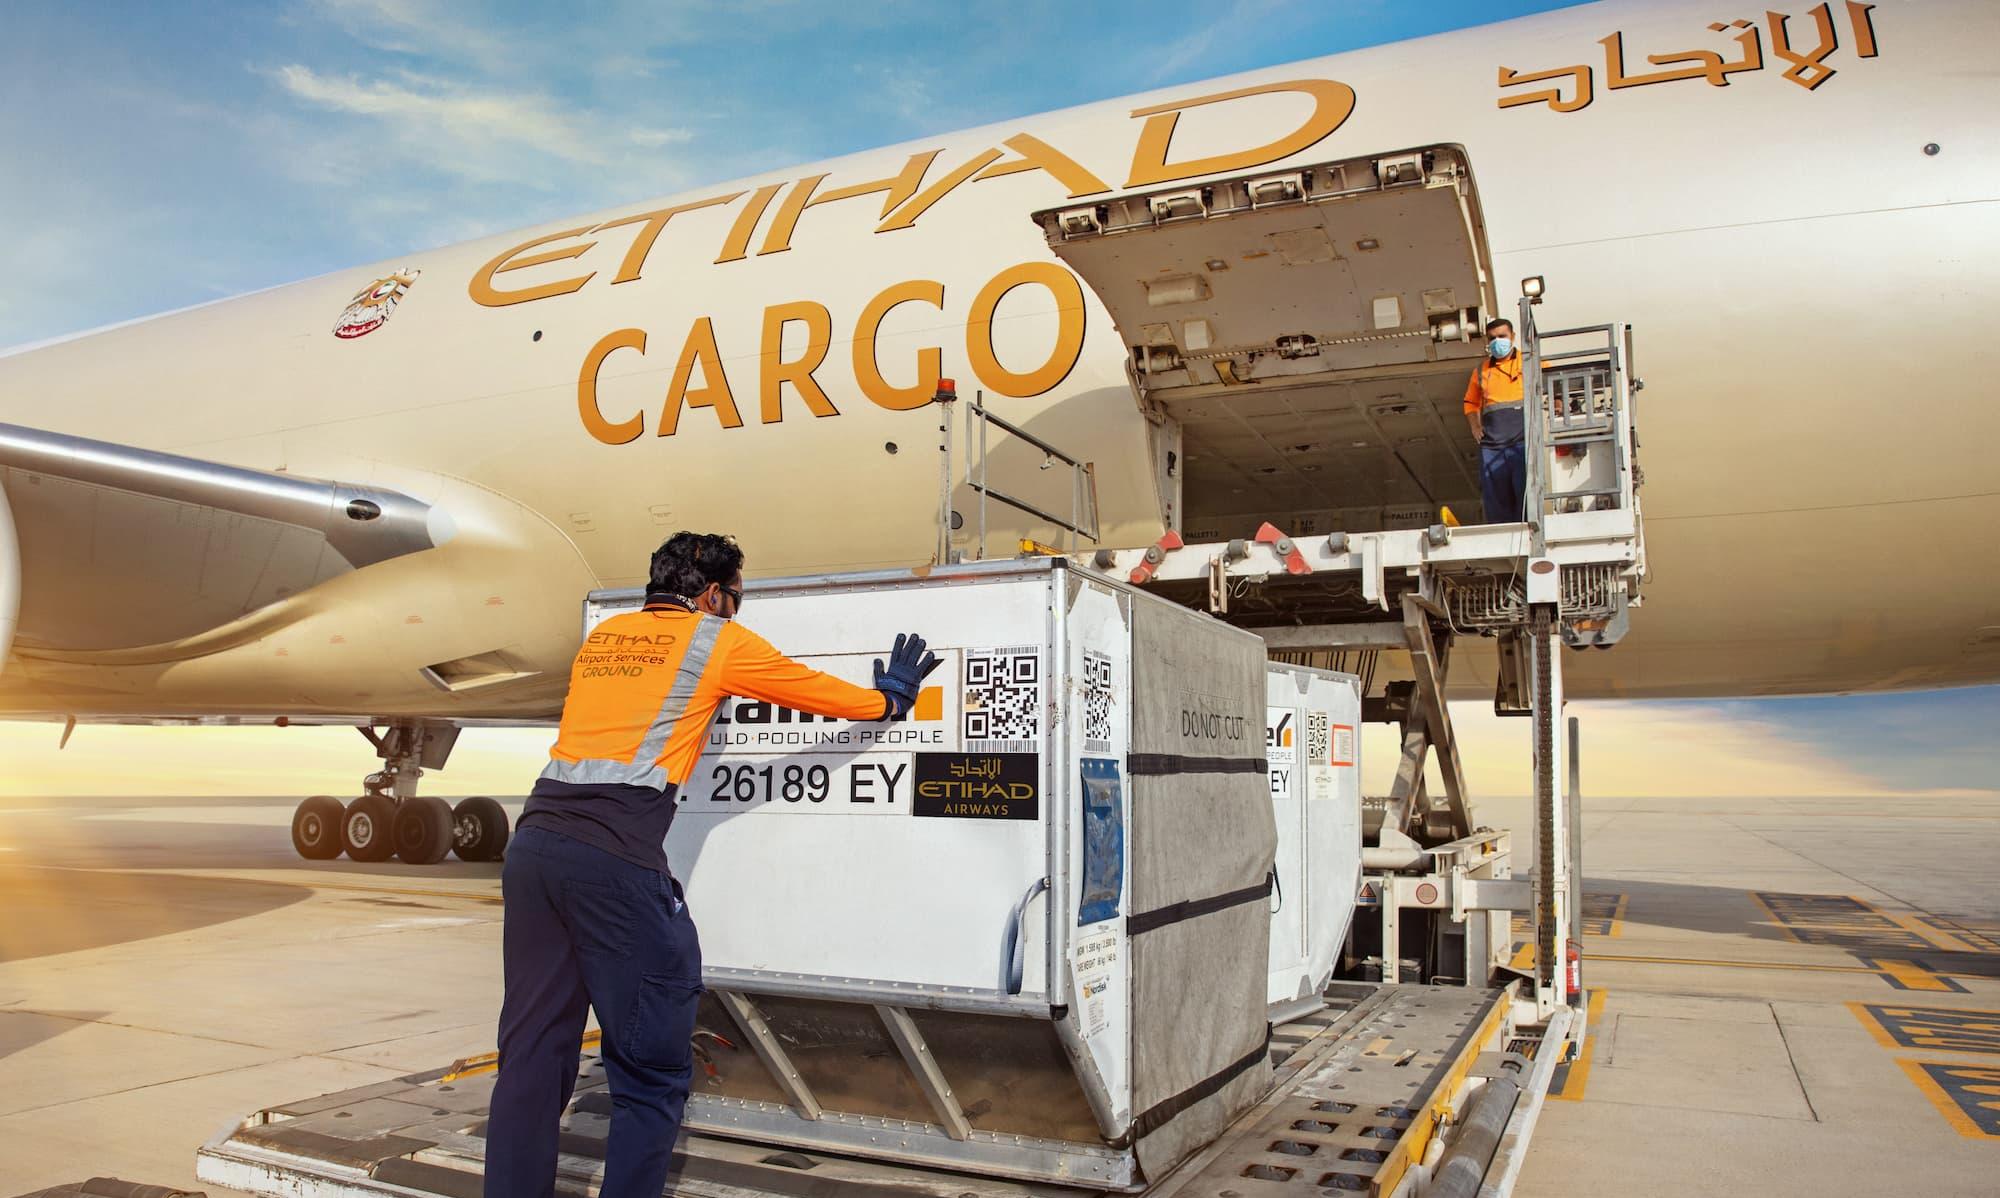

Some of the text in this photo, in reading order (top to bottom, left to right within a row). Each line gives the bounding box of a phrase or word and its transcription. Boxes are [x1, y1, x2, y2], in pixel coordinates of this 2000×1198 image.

[1497, 0, 1879, 112] الاتحاد
[468, 79, 1356, 307] ETIHAD
[578, 261, 1087, 445] CARGO
[588, 632, 676, 646] ETIHAD
[577, 654, 611, 665] Airport
[582, 665, 643, 678] GROUND
[1182, 709, 1199, 738] DO
[1200, 712, 1221, 739] NOT
[1225, 715, 1244, 740] CUT
[710, 730, 944, 745] ULD POOLING PEOPLE
[951, 758, 1002, 780] الاتحاد
[710, 763, 907, 803] 26189 EY
[919, 781, 1034, 800] ETIHAD
[1271, 770, 1289, 792] EY
[944, 803, 1009, 816] AIRWAYS
